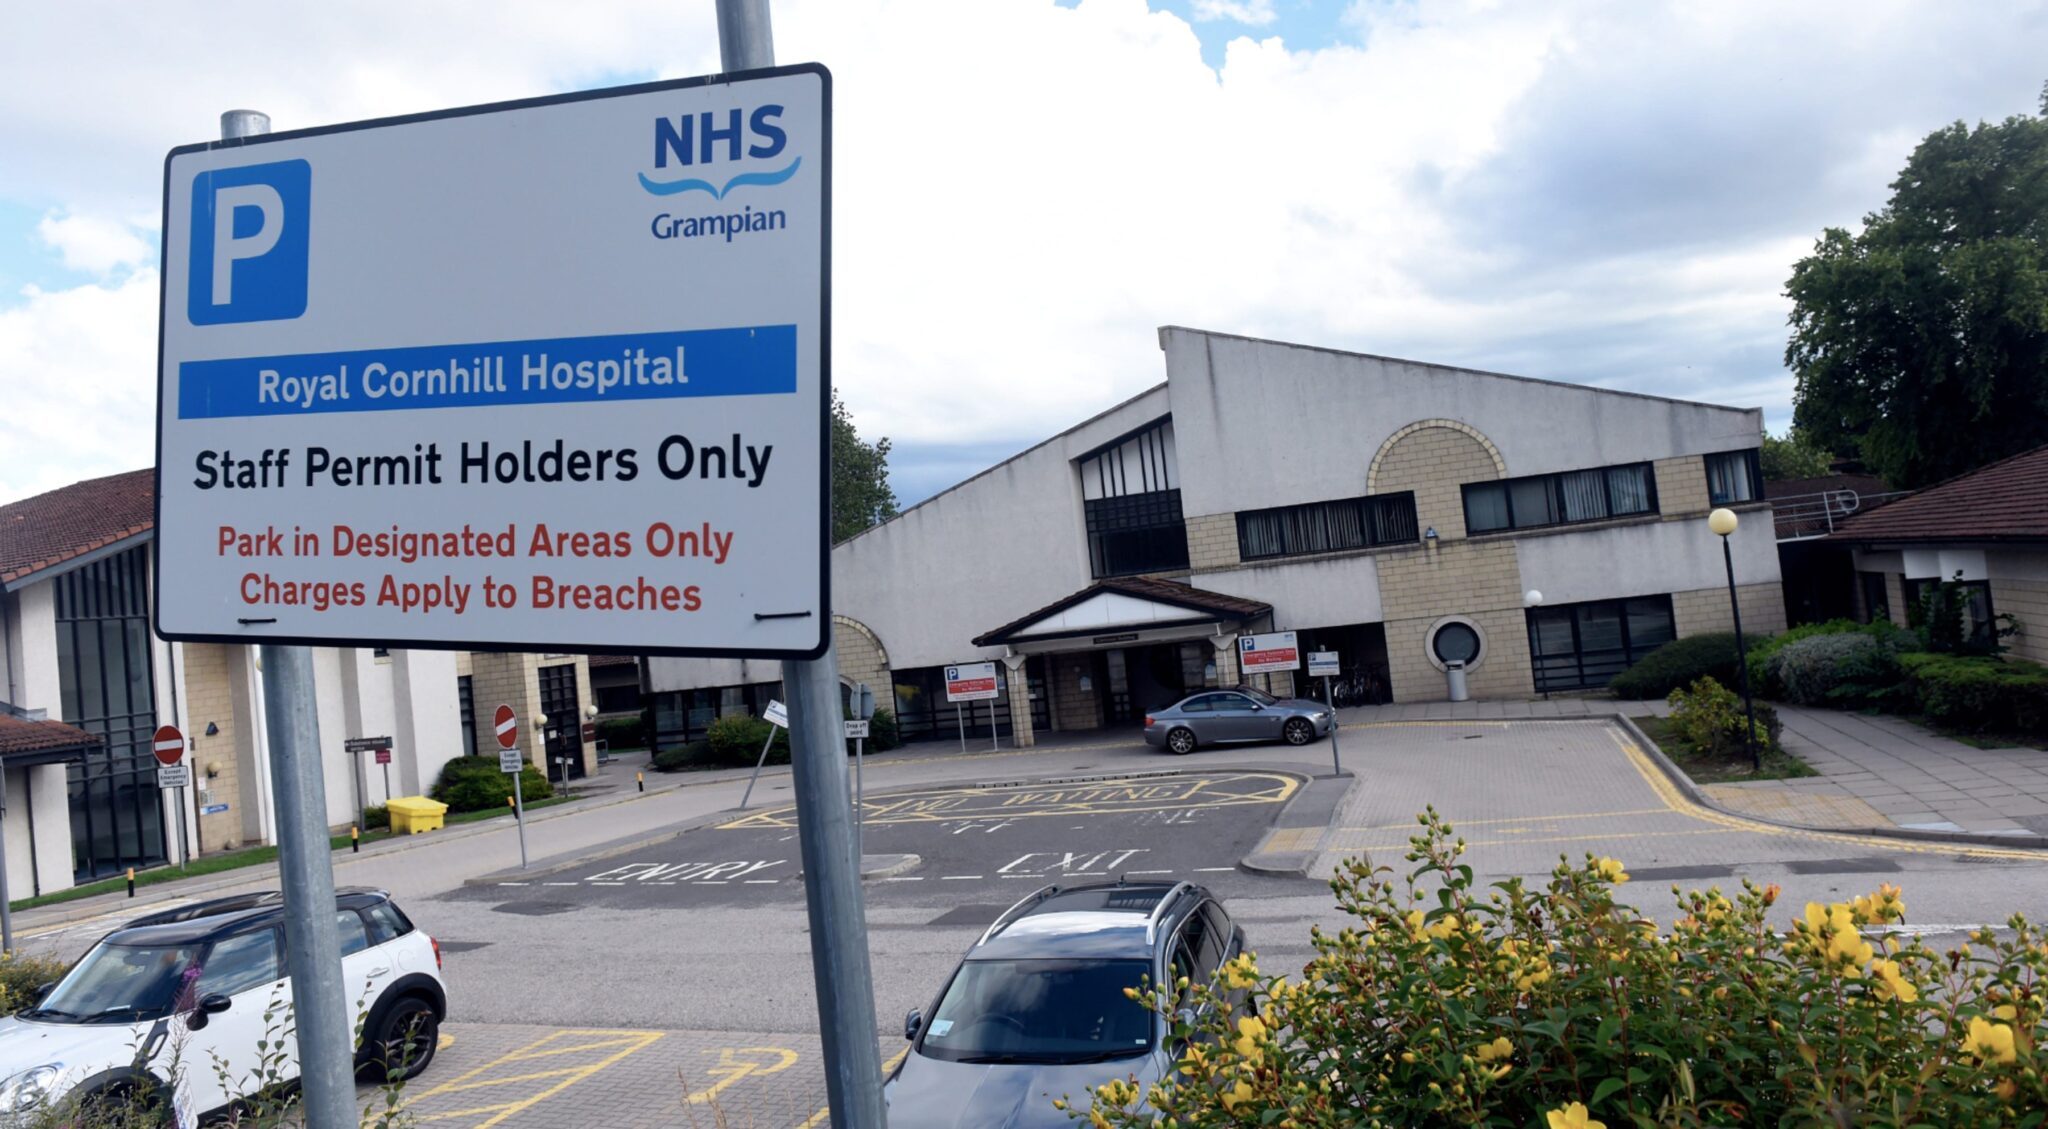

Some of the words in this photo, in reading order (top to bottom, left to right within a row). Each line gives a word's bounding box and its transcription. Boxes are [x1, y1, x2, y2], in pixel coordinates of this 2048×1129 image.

[654, 103, 788, 169] NHS
[212, 184, 285, 305] P
[651, 206, 787, 243] Grampian
[258, 365, 349, 409] Royal
[362, 356, 507, 398] Cornhill
[522, 346, 689, 394] Hospital
[193, 448, 291, 490] Staff
[306, 442, 442, 487] Permit
[460, 438, 639, 484] Holders
[657, 433, 773, 489] Only
[218, 525, 283, 557] Park
[294, 525, 320, 557] in
[333, 524, 516, 564] Designated
[529, 523, 633, 558] Areas
[645, 522, 734, 565] Only
[240, 573, 366, 612] Charges
[377, 575, 471, 615] Apply
[483, 576, 517, 609] to
[532, 575, 703, 612] Breaches
[1001, 785, 1179, 806] WAITING
[584, 859, 788, 881] ENTRY
[996, 849, 1151, 873] EXIT
